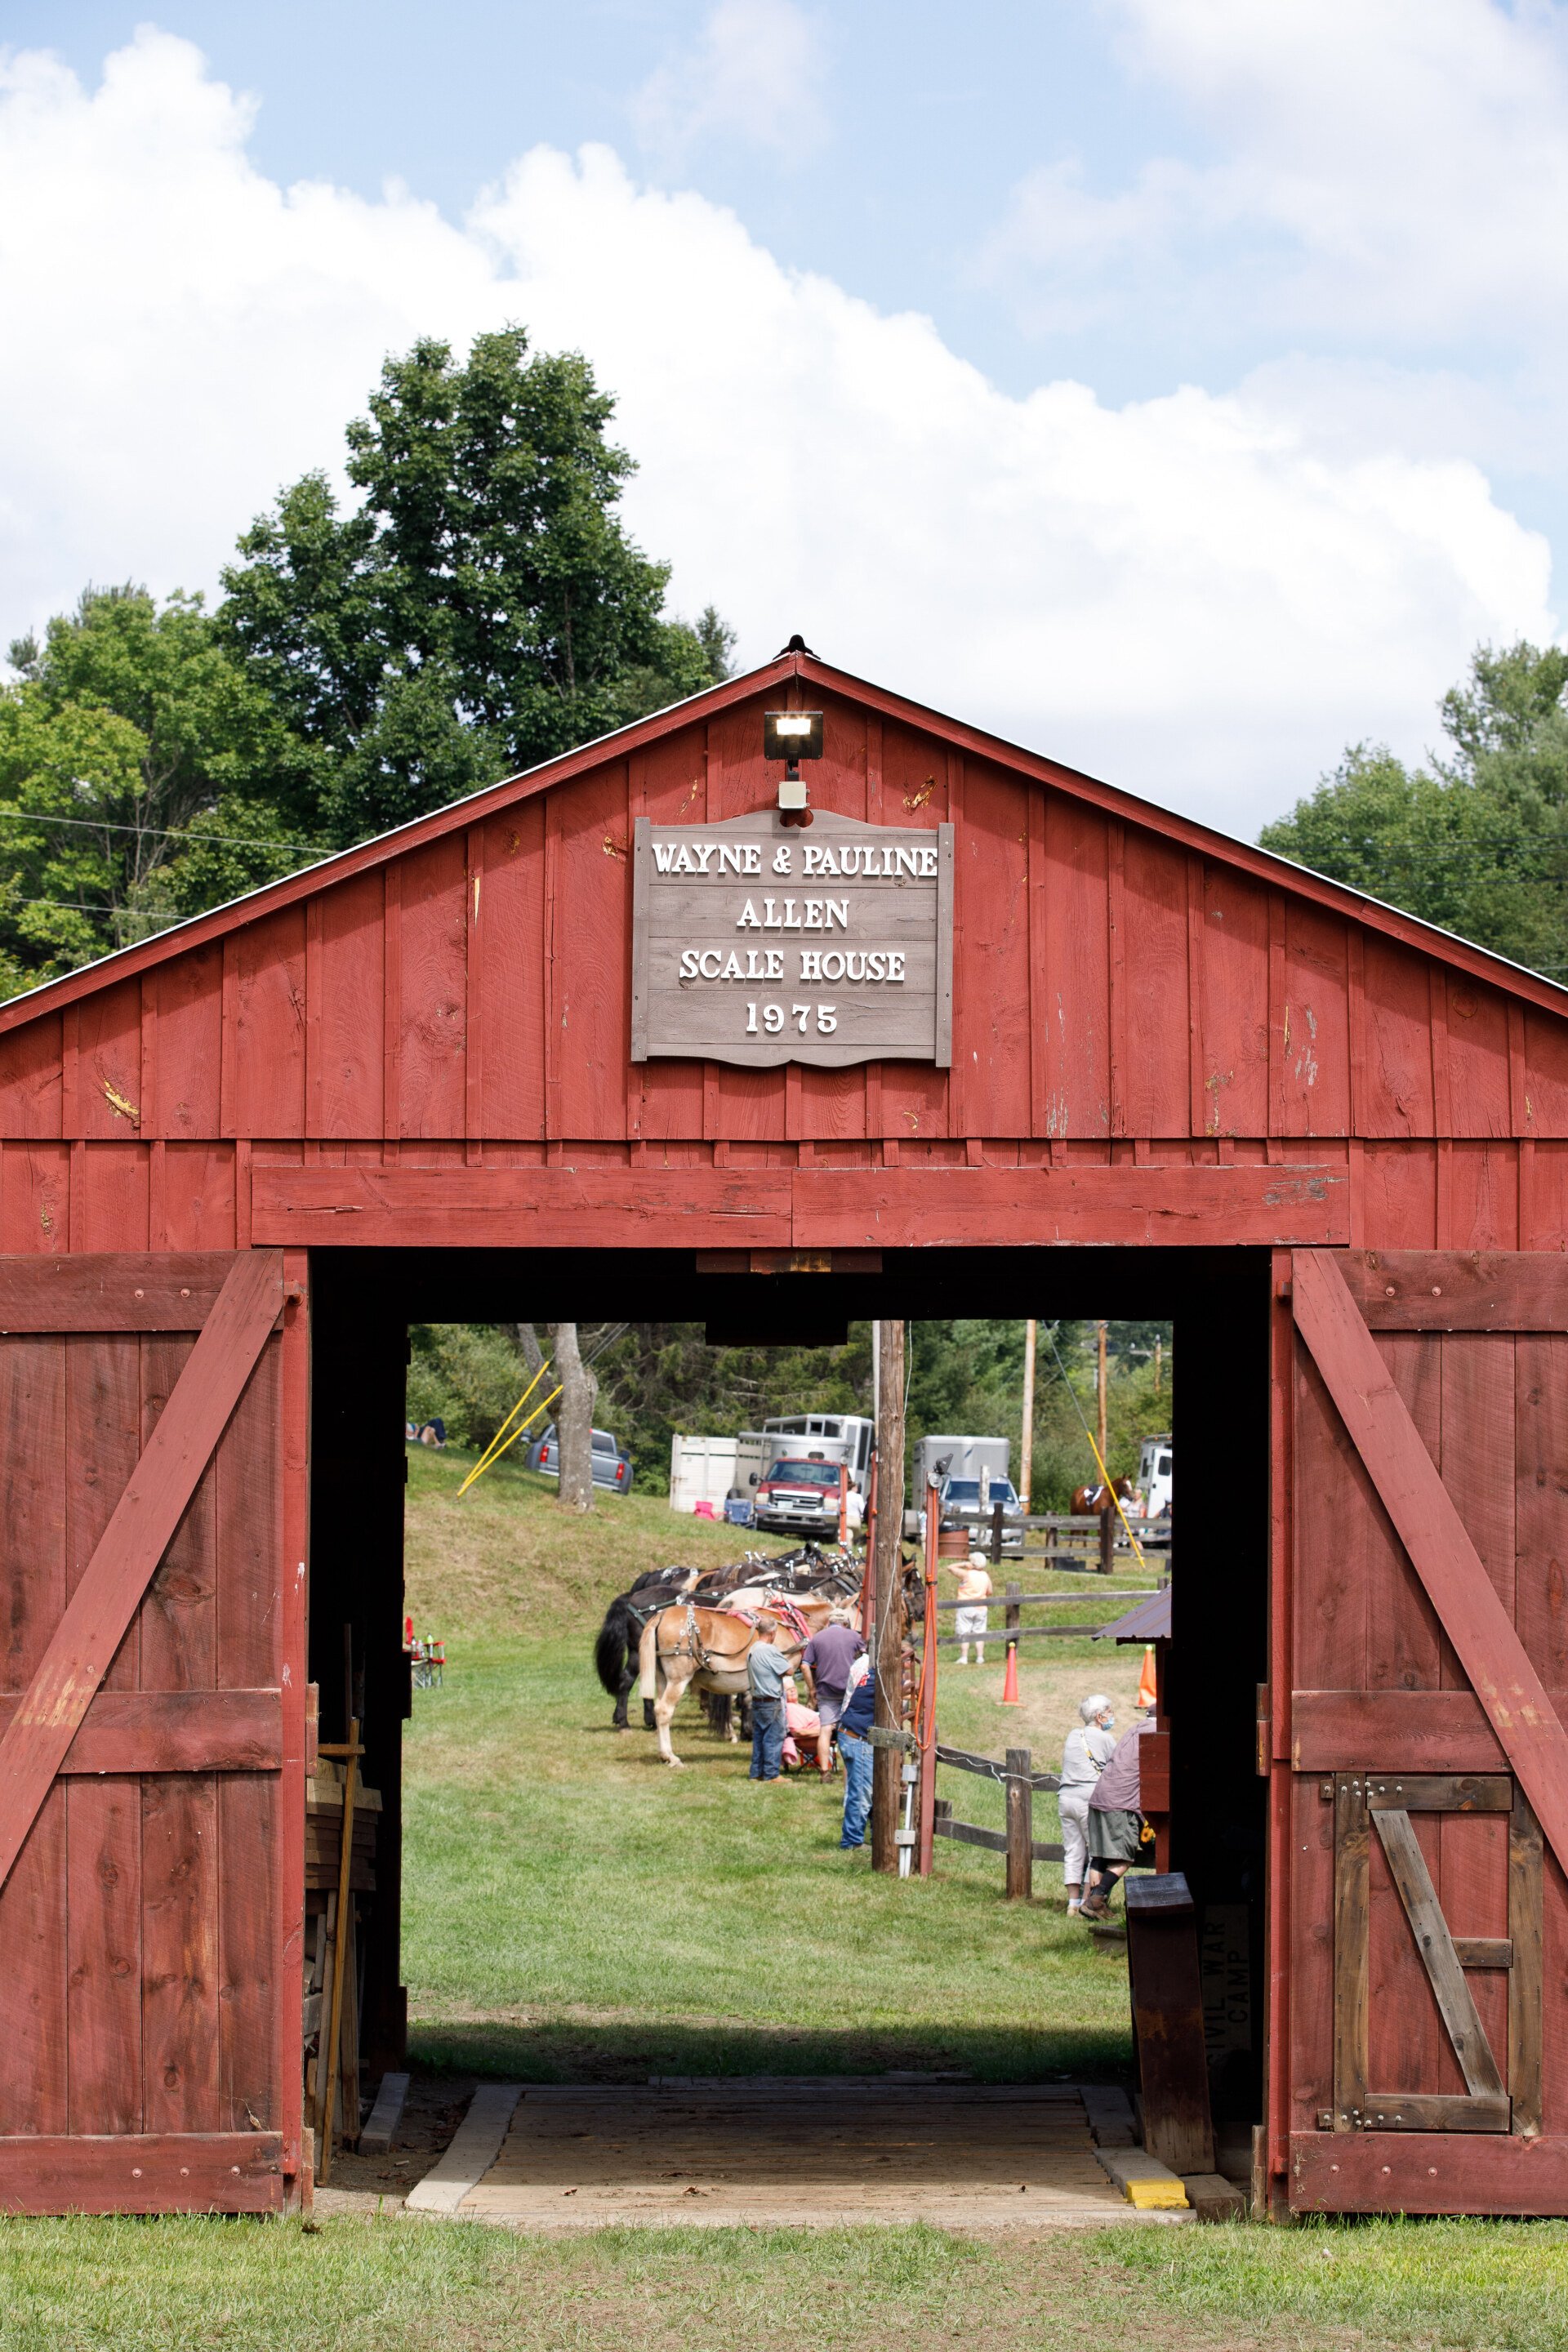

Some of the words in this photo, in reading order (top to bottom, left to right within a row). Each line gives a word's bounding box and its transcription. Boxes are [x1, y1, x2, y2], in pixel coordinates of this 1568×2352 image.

[653, 844, 761, 874] WAYNE
[773, 845, 792, 874] &
[803, 846, 938, 876] PAULINE
[737, 898, 849, 928] ALLEN
[679, 950, 784, 979] SCALE
[800, 951, 905, 981] HOUSE
[746, 1003, 837, 1032] 1975
[1205, 1922, 1225, 1976] WAR
[1227, 1951, 1249, 2023] CAMP
